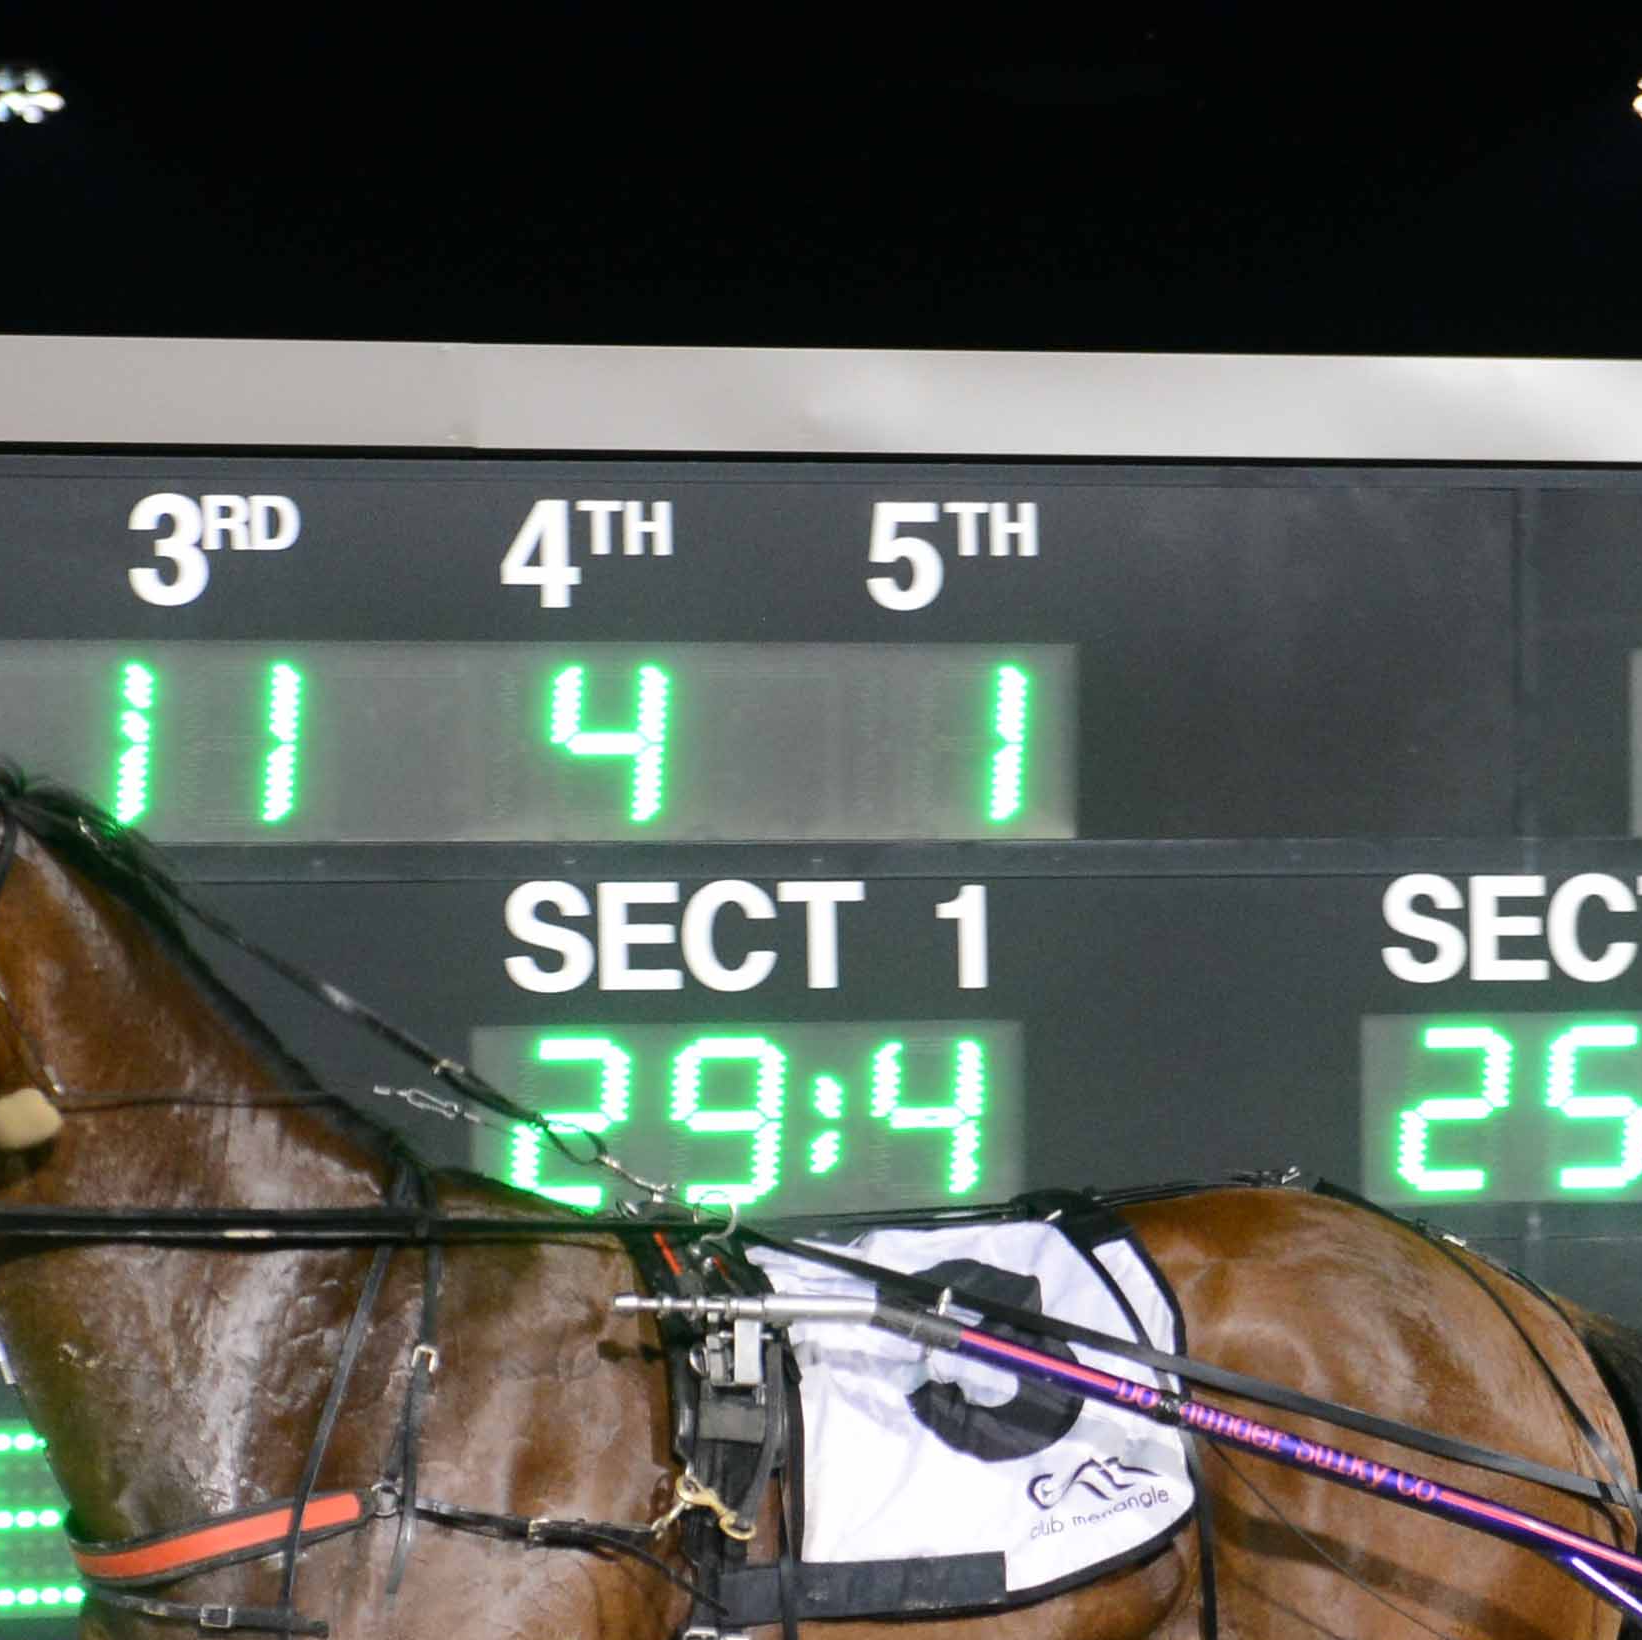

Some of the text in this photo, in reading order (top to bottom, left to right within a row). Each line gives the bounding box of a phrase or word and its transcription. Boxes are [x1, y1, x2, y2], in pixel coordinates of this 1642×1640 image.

[128, 492, 300, 607] 3RD
[500, 499, 673, 609] 4TH
[866, 501, 1039, 611] 5TH
[547, 664, 671, 823] 4
[985, 664, 1030, 824] 1
[504, 879, 988, 993] SECT 1
[1030, 1512, 1065, 1540] club
